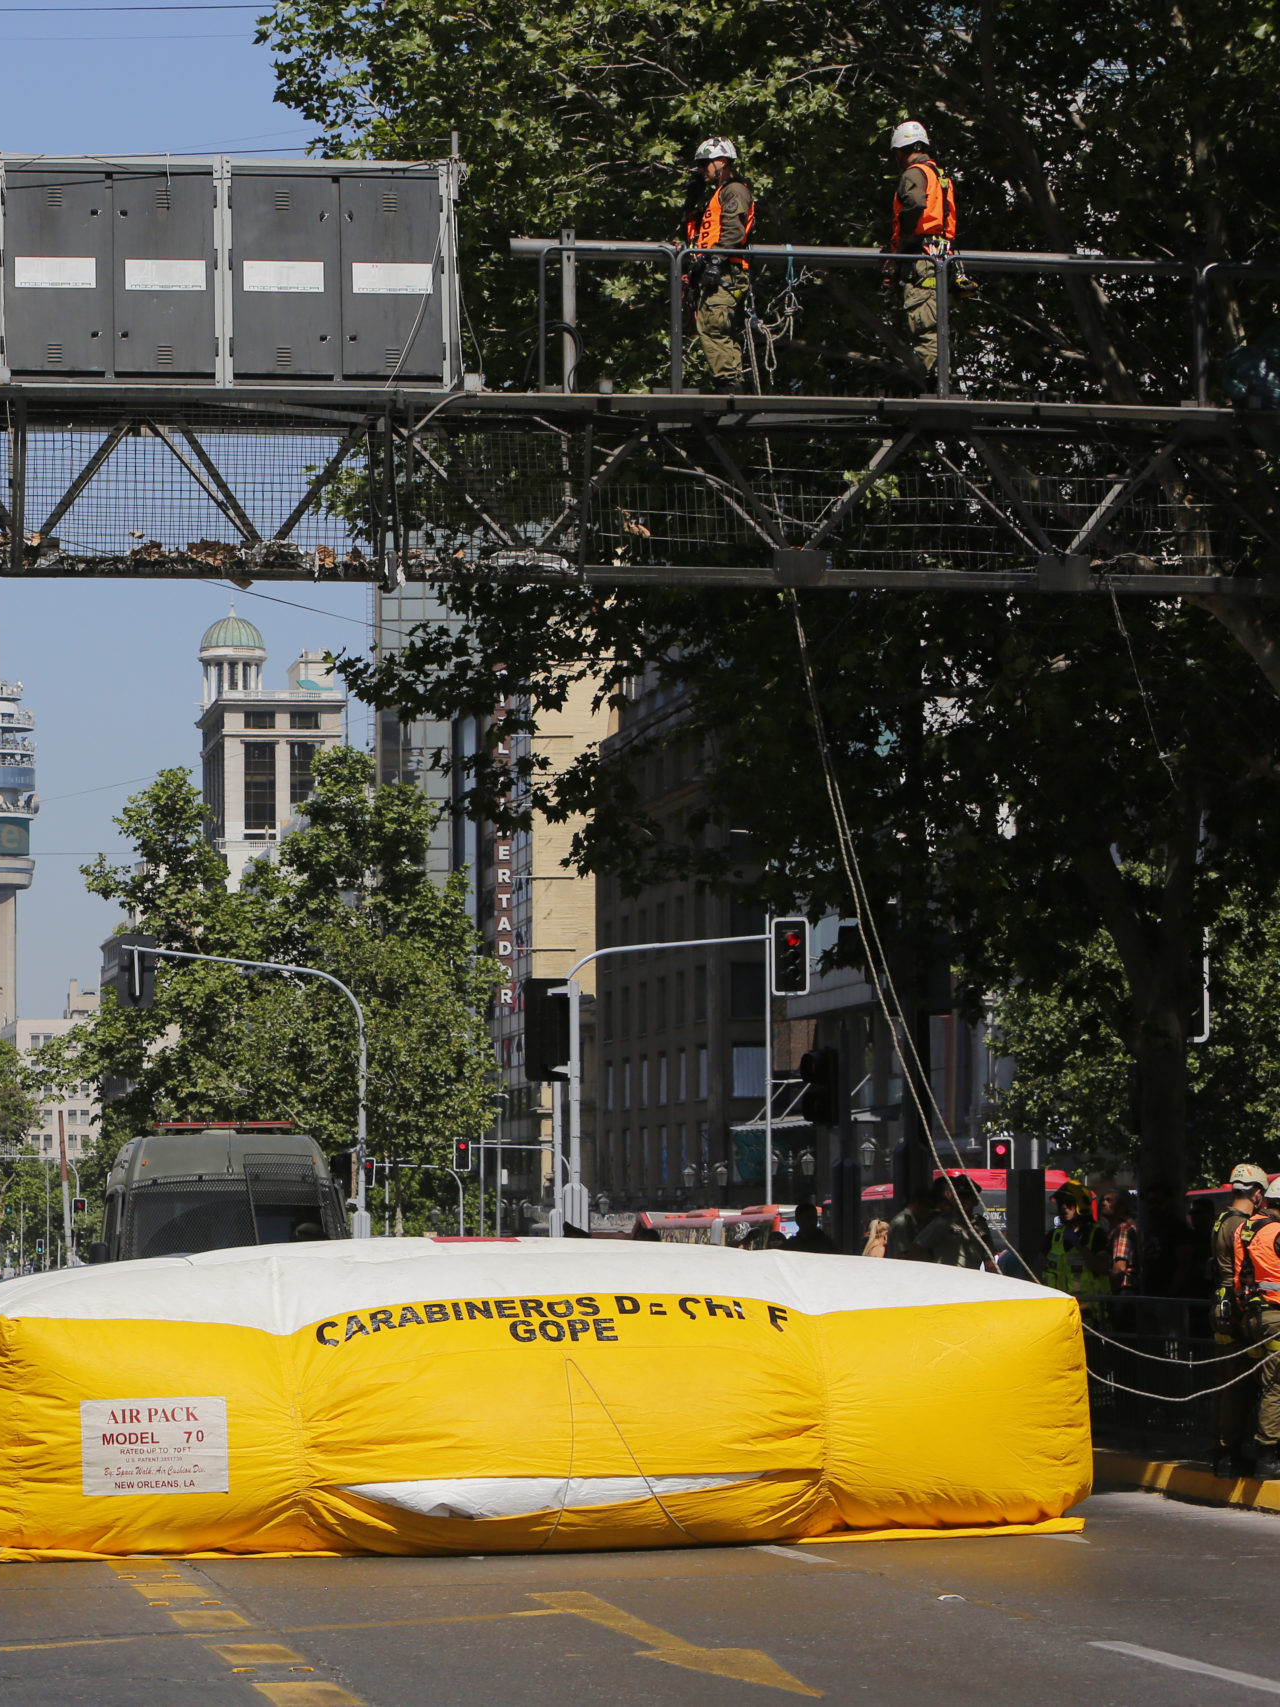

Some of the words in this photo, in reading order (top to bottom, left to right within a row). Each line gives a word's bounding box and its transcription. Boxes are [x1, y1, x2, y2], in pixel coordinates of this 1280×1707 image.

[316, 1296, 600, 1347] CARABINEROS
[509, 1318, 618, 1343] GOPE
[107, 1408, 142, 1425] AIR
[147, 1406, 200, 1423] PACK
[102, 1432, 160, 1446] MODEL
[183, 1430, 205, 1444] 70
[120, 1447, 145, 1455] RATED
[146, 1447, 158, 1455] UP
[115, 1466, 134, 1478] Space
[155, 1466, 166, 1475] Air
[167, 1465, 192, 1476] Cushion
[114, 1480, 135, 1489] NEW
[137, 1479, 182, 1489] ORLEANS,
[183, 1479, 195, 1488] LA
